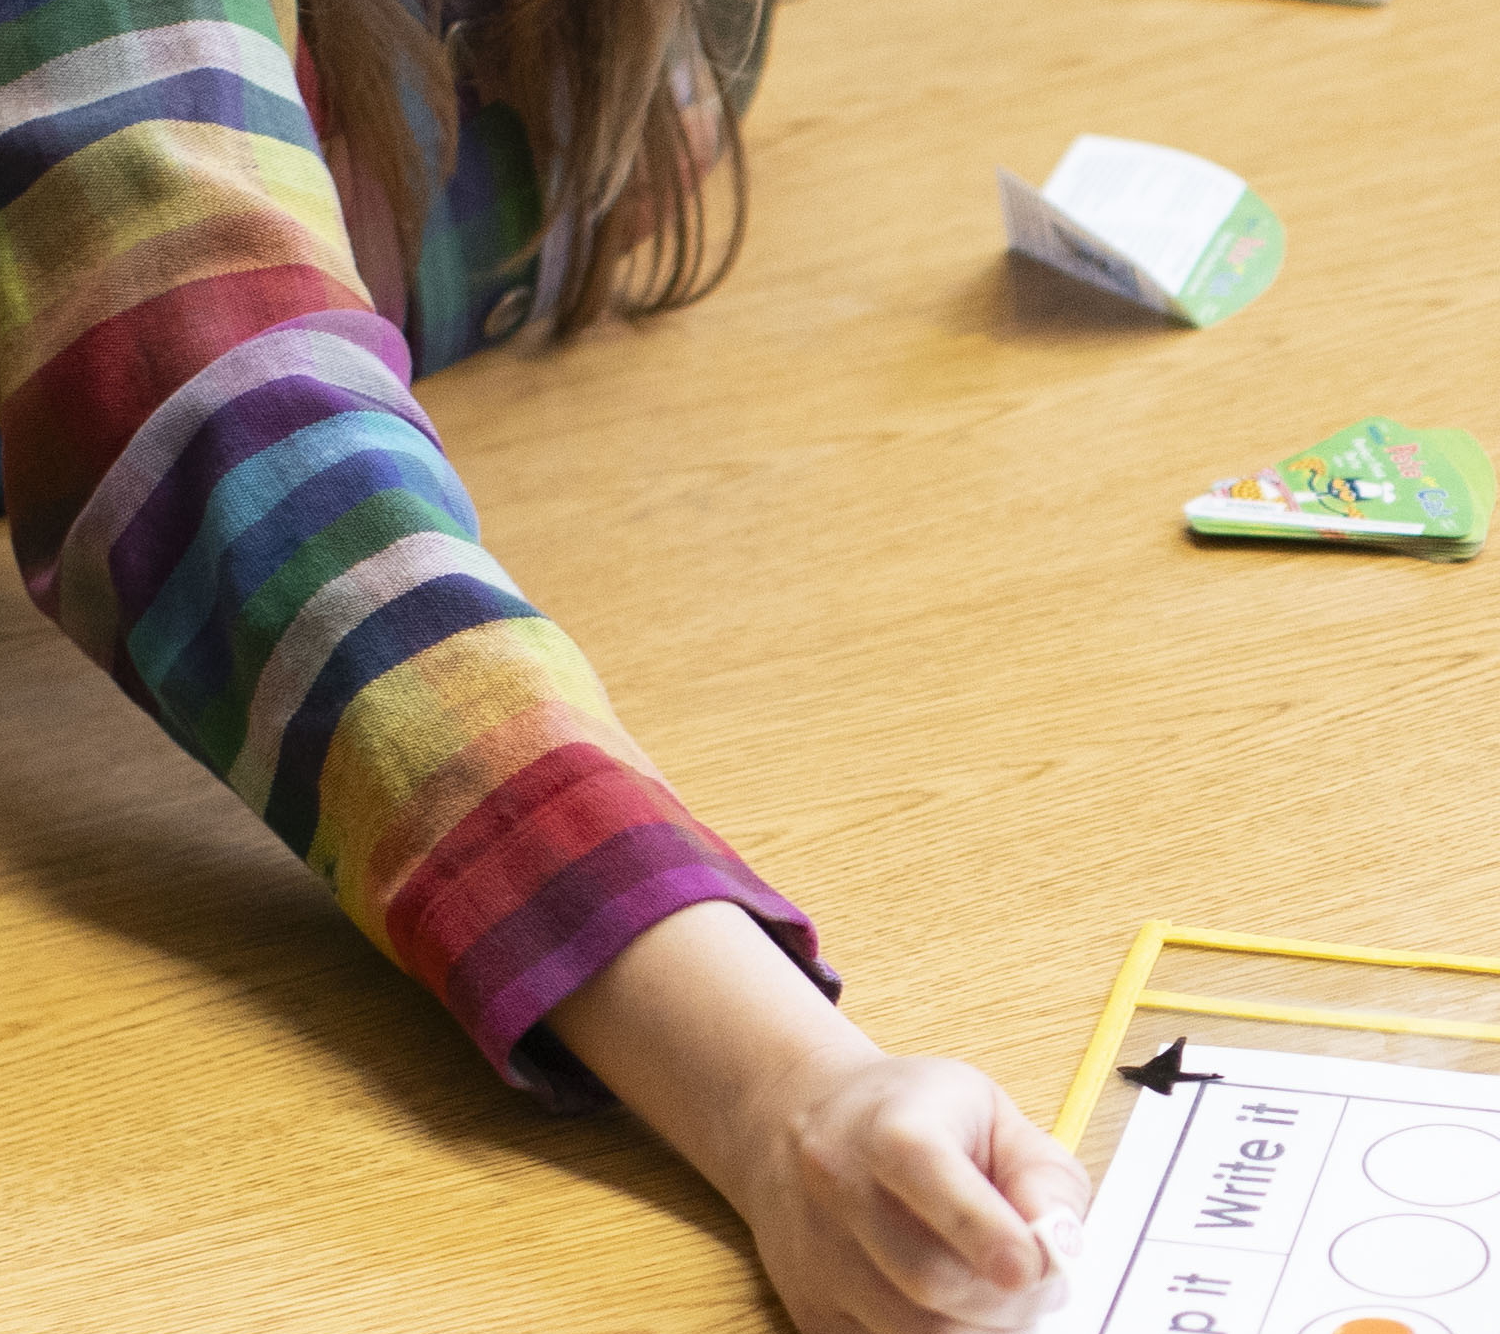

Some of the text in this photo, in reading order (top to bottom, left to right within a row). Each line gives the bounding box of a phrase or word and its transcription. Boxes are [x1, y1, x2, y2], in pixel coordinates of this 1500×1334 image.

[1194, 1102, 1300, 1230] Write it
[1166, 1273, 1232, 1297] it
